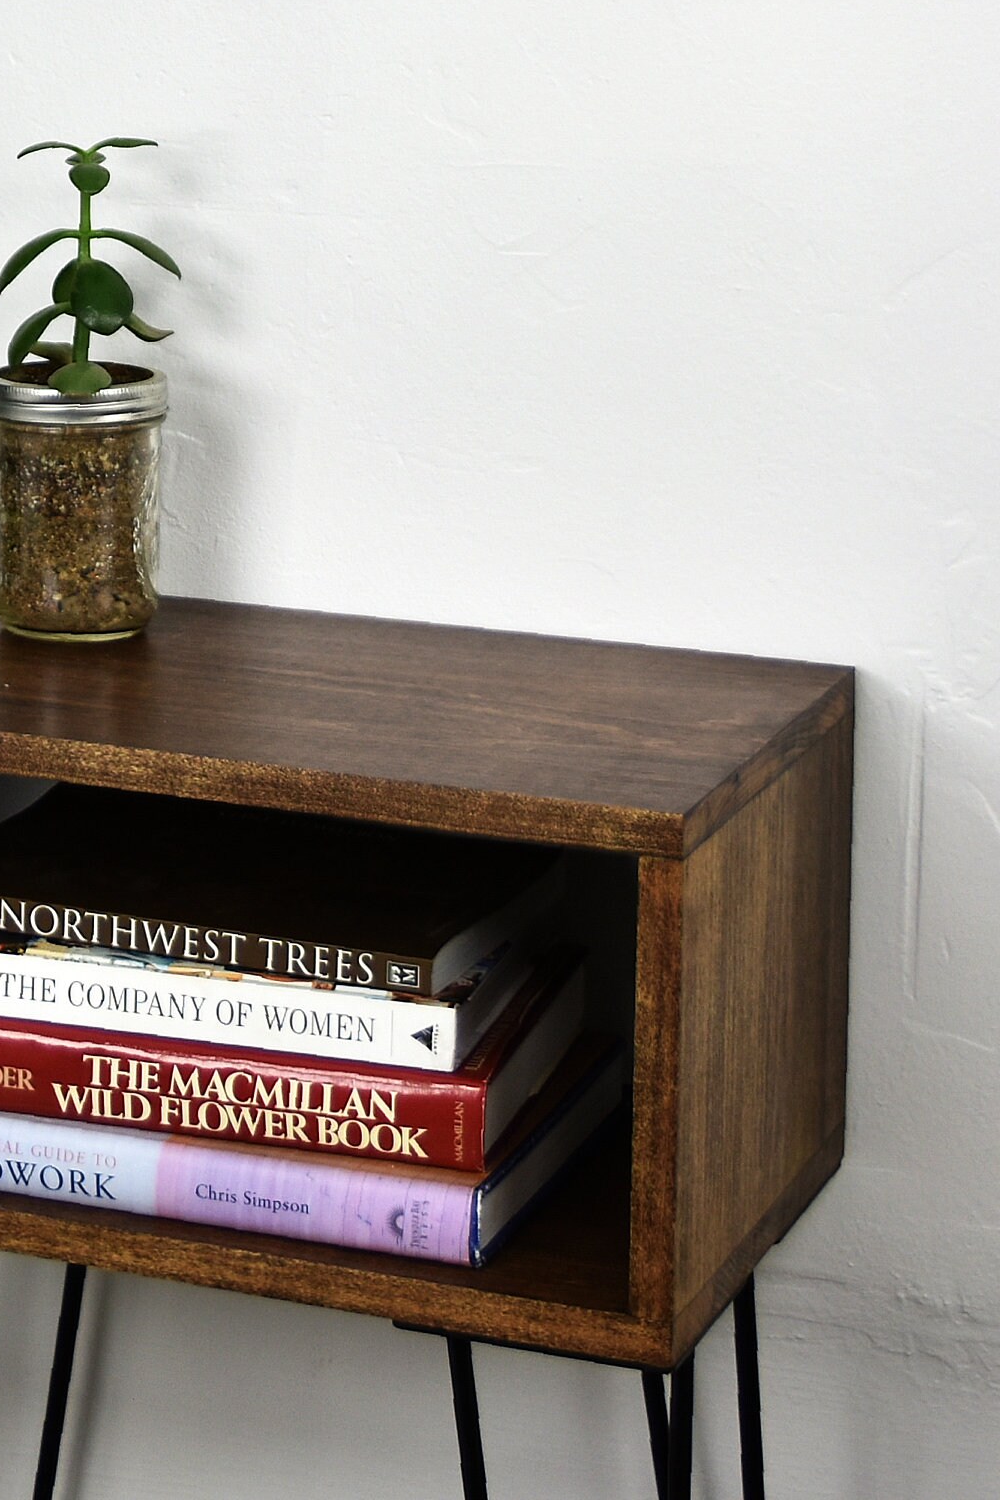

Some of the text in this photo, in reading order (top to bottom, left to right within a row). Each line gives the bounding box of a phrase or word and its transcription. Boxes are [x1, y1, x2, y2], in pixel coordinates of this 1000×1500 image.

[258, 936, 374, 985] TREES
[67, 980, 207, 1022] COMPANY
[216, 999, 253, 1028] OF
[263, 1005, 376, 1043] WOMEN
[83, 1053, 399, 1124] THE MACMILLAN
[51, 1082, 430, 1159] WILD FLOWER BOOK
[454, 1100, 466, 1163] MACMILLAN
[30, 1143, 86, 1165] GUIDE
[94, 1153, 118, 1169] TO
[194, 1183, 310, 1215] Chris Simpson
